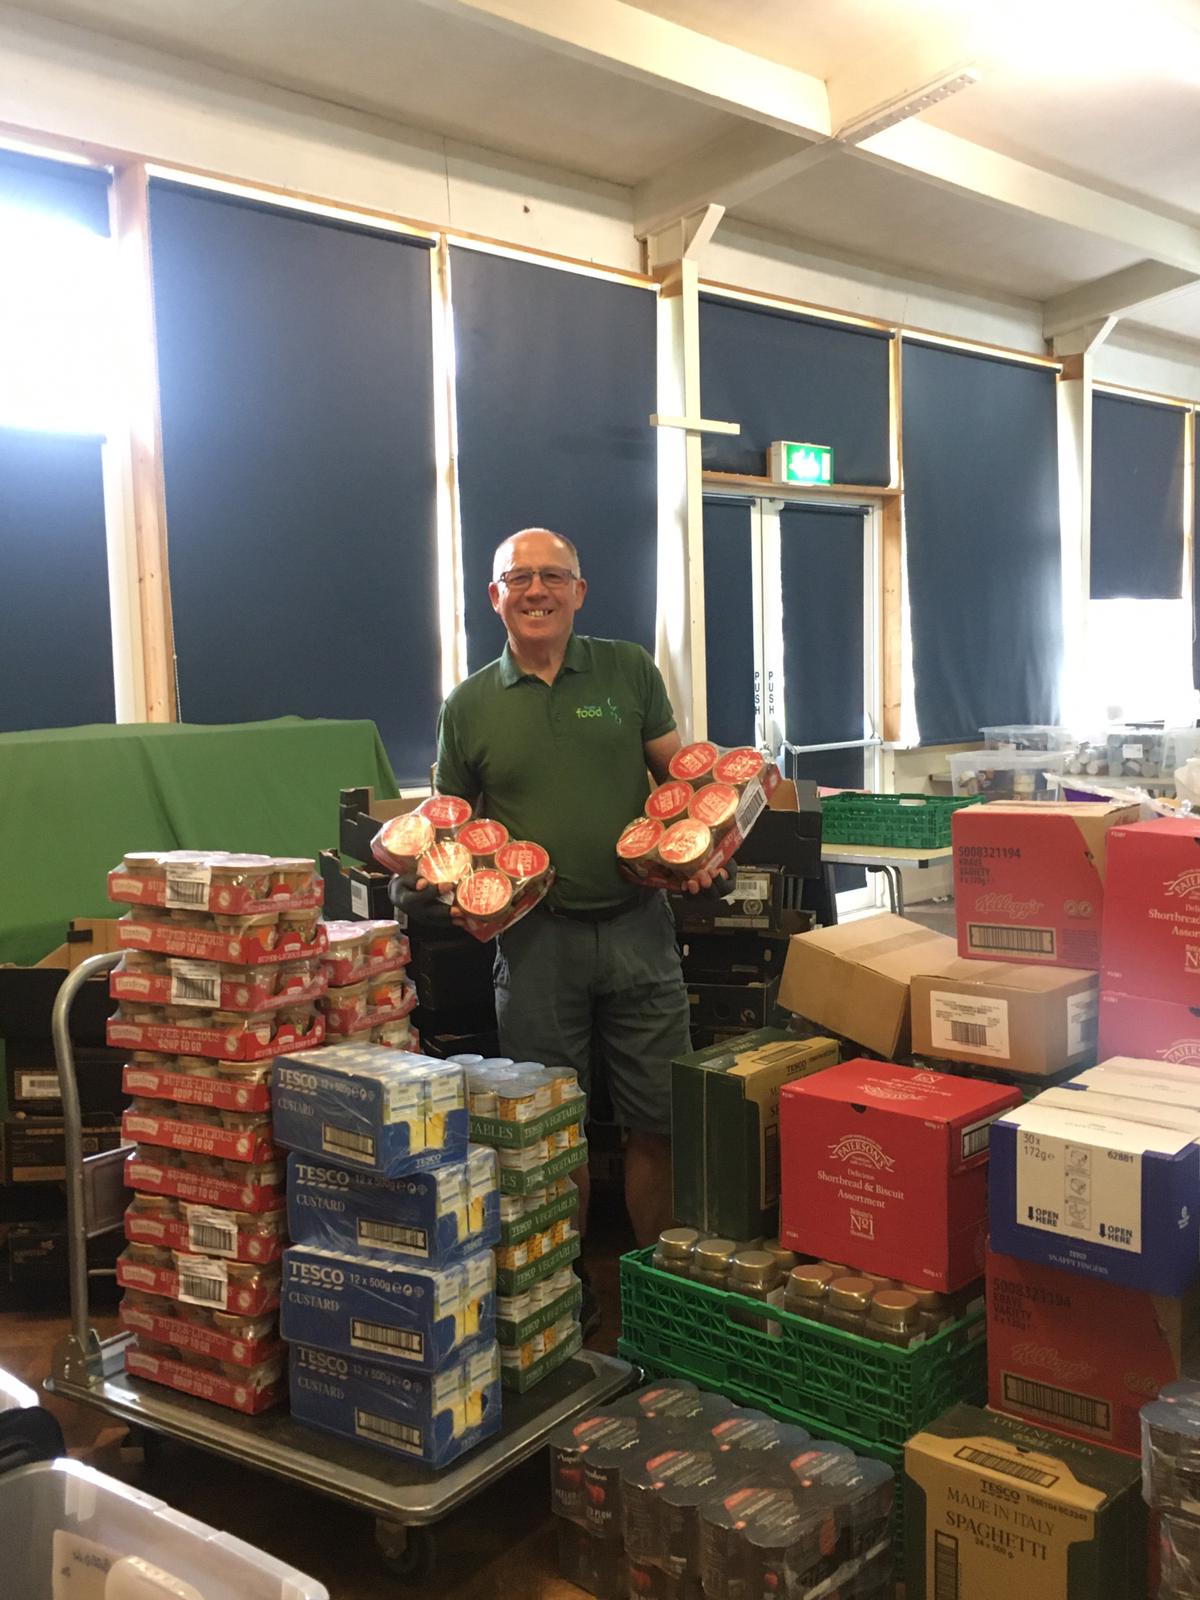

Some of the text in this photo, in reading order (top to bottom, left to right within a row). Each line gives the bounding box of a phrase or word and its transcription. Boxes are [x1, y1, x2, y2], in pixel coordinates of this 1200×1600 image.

[576, 706, 602, 718] food
[976, 892, 1044, 920] Kellogg's
[158, 1039, 178, 1050] SOUP
[786, 1060, 808, 1074] TESCO
[278, 1067, 318, 1090] TESCO
[278, 1098, 314, 1116] CUSTARD
[546, 1104, 586, 1128] VEGETABLES
[470, 1121, 513, 1139] TABLES
[1024, 1133, 1034, 1144] 30
[416, 1154, 442, 1166] TESCO
[1024, 1146, 1046, 1161] 172g
[296, 1164, 350, 1186] TESCO
[817, 1170, 904, 1200] Shortbread & Biscuit
[296, 1194, 346, 1213] CUSTARD
[838, 1188, 886, 1208] Assortment
[536, 1196, 577, 1226] VEGETABLES
[1035, 1208, 1059, 1220] OPEN
[1035, 1216, 1057, 1227] HERE
[1108, 1225, 1132, 1238] OPEN
[1108, 1234, 1131, 1245] HERE
[288, 1260, 345, 1286] TESCO
[350, 1272, 362, 1284] 12
[369, 1276, 391, 1294] 500g
[288, 1291, 340, 1312] CUSTARD
[298, 1347, 348, 1374] TESCO
[298, 1375, 345, 1400] CUSTARD
[980, 1480, 1020, 1500] TESCO
[947, 1486, 990, 1512] MADE
[994, 1504, 1009, 1520] IN
[1014, 1510, 1055, 1536] ITALY
[946, 1510, 1048, 1560] SPAGHETTI
